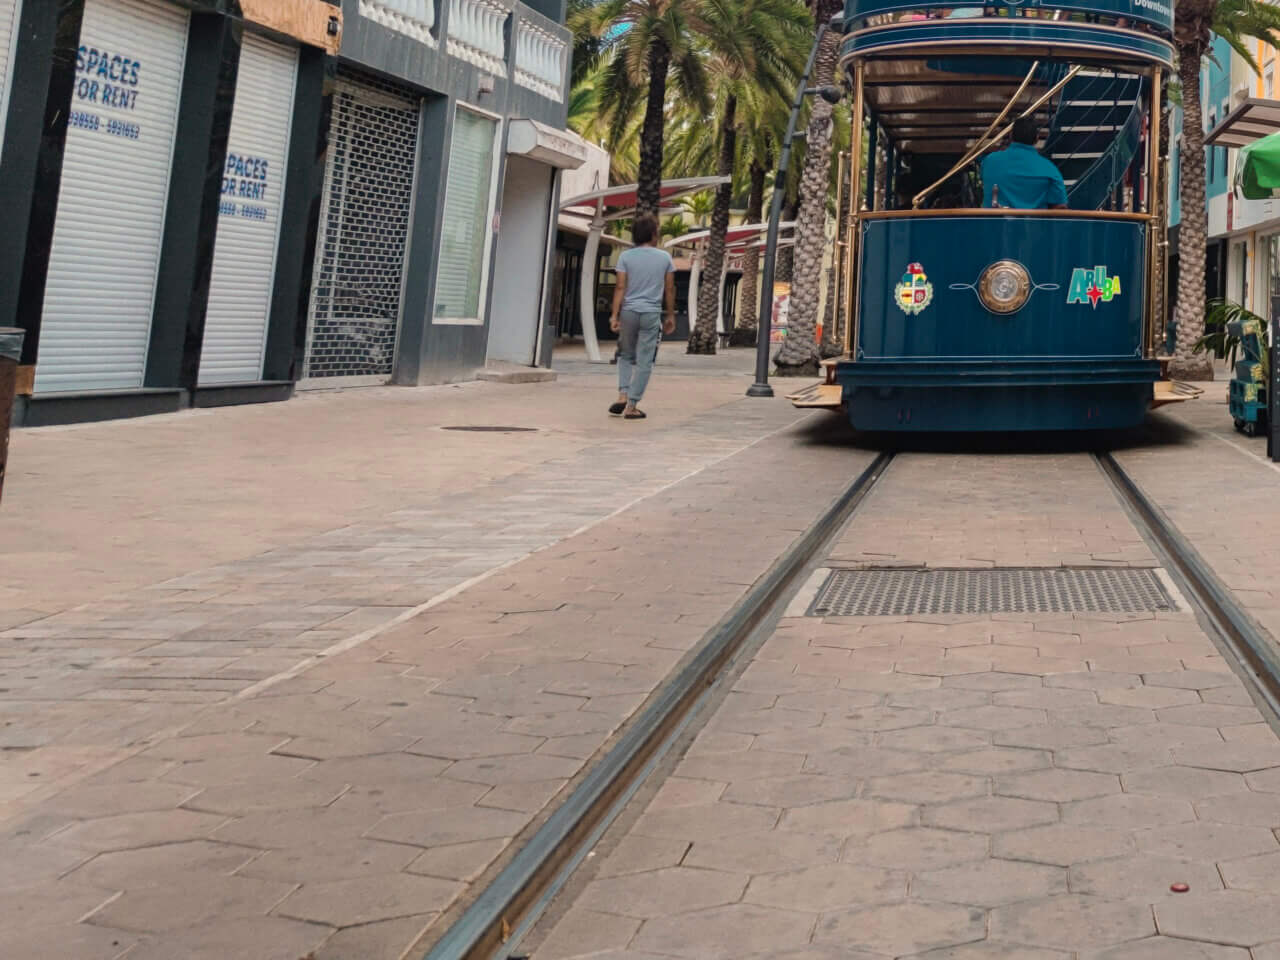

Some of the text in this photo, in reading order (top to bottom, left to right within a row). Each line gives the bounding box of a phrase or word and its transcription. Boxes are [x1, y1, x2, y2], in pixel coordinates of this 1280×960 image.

[74, 43, 141, 87] SPACES
[76, 77, 139, 110] OR RENT
[227, 153, 269, 180] PACES
[220, 176, 268, 201] OR RENT
[1066, 264, 1122, 305] ARUBA
